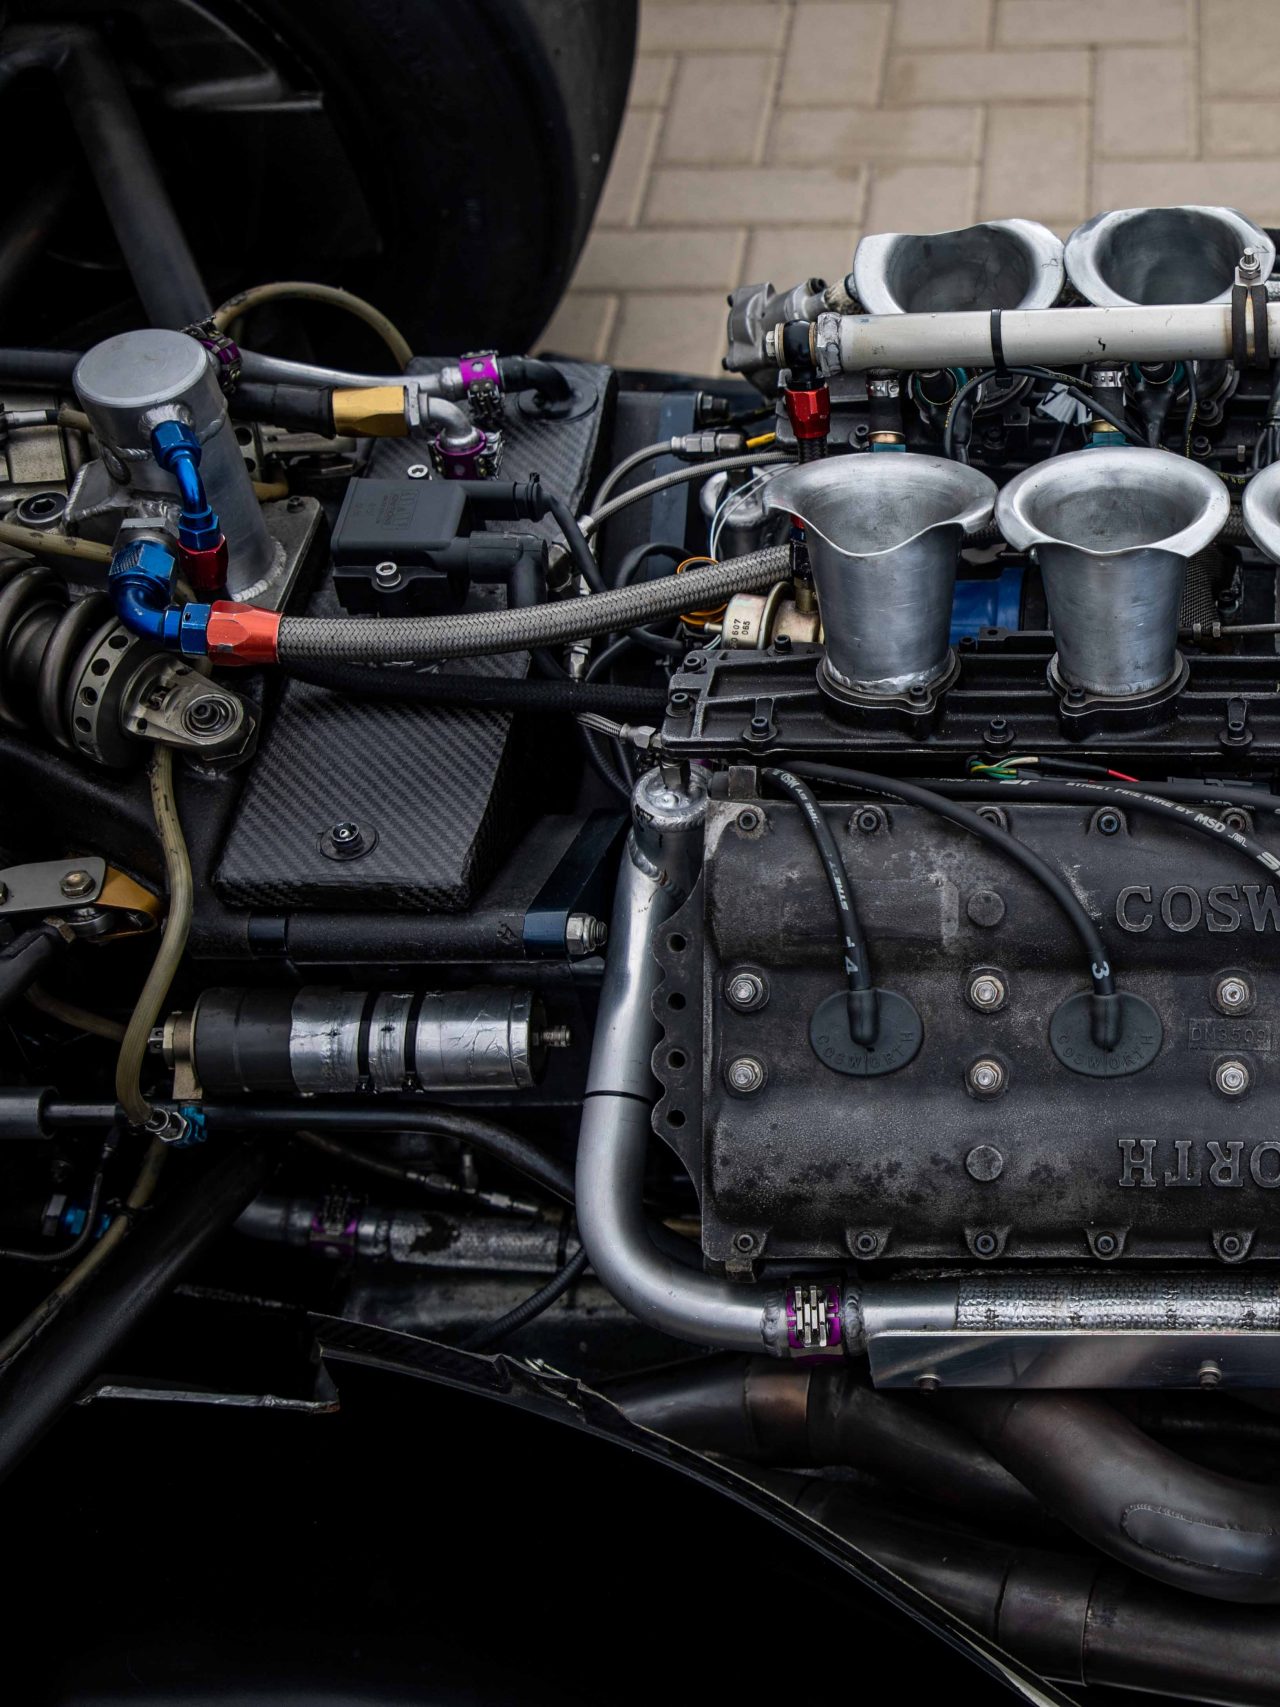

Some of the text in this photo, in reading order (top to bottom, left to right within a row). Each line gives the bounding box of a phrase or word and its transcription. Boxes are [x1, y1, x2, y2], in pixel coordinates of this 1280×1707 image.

[731, 618, 741, 636] 607
[779, 770, 800, 790] MSD
[1066, 781, 1226, 833] STREET FIRE WIRE BY MSD
[844, 954, 859, 975] 4
[1091, 960, 1110, 981] 3
[816, 1031, 914, 1069] COSWORTH
[1057, 1034, 1154, 1069] COSWORTH
